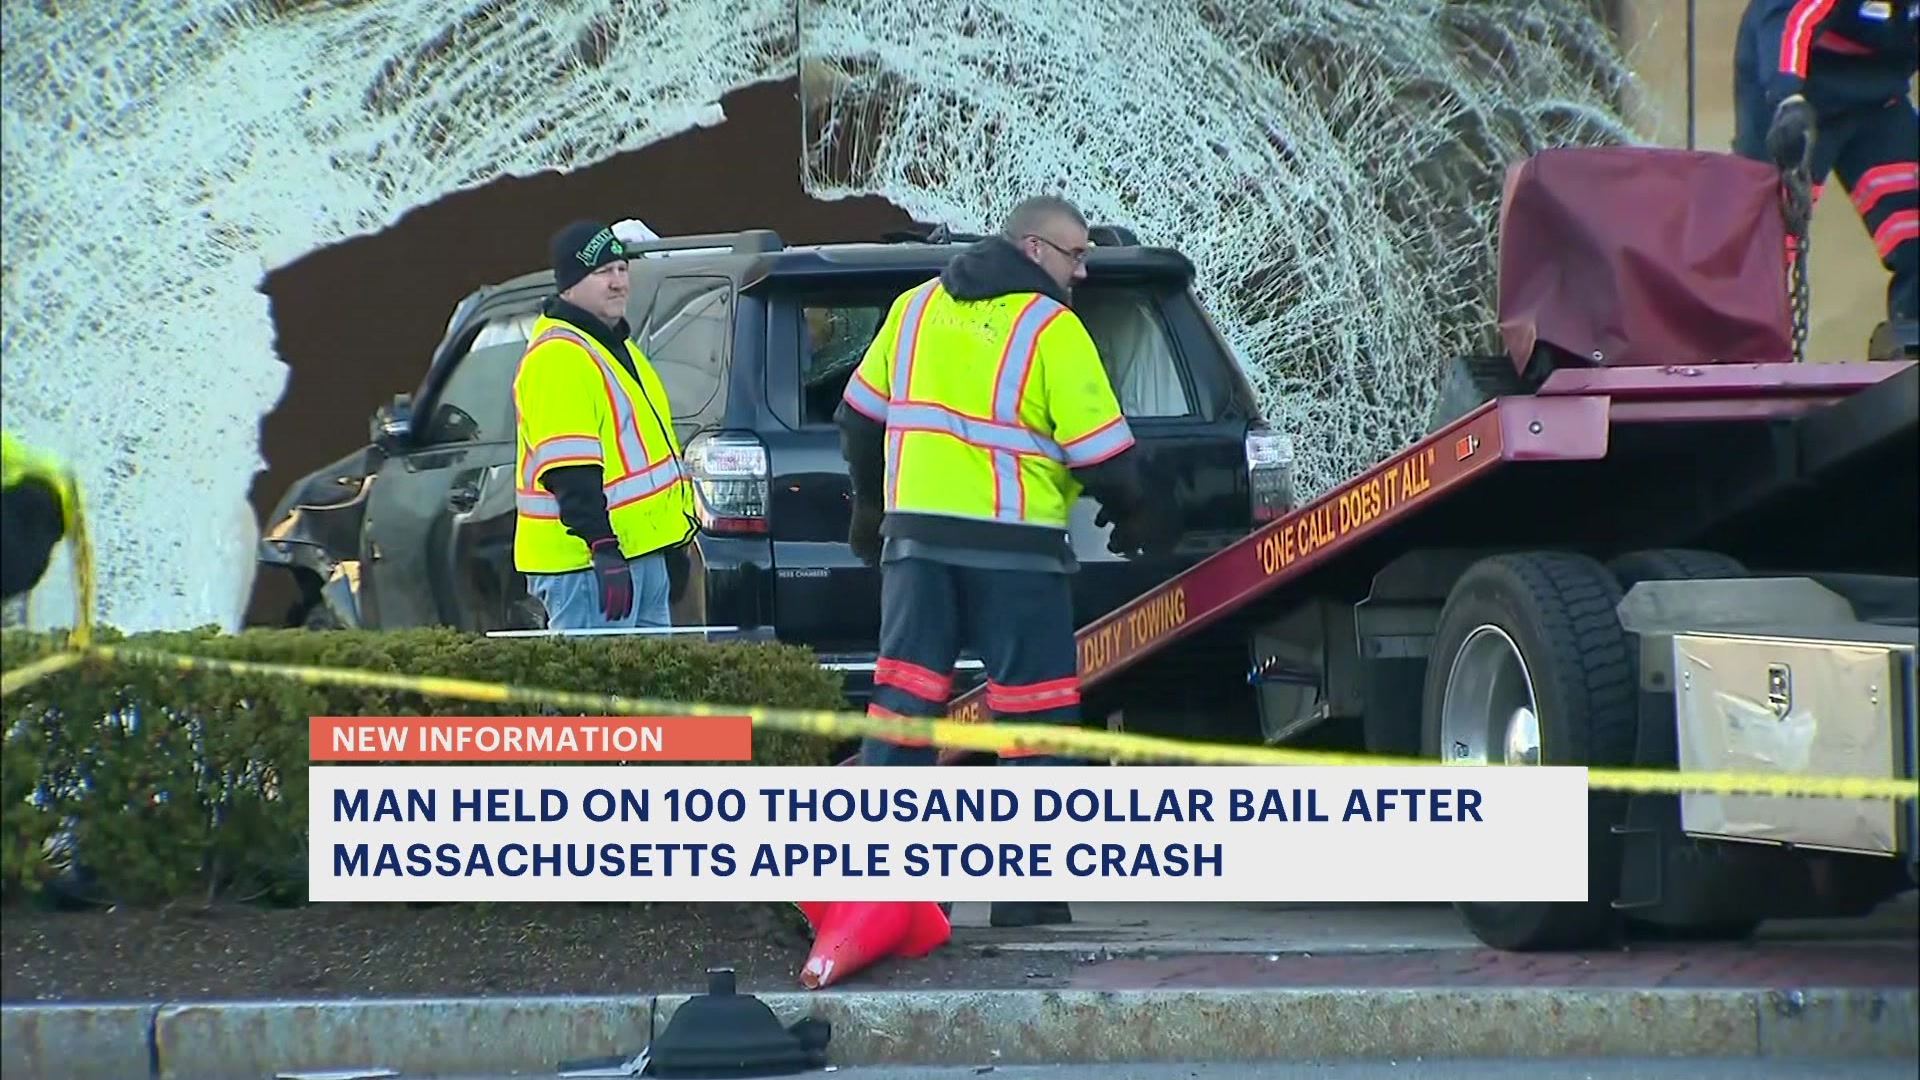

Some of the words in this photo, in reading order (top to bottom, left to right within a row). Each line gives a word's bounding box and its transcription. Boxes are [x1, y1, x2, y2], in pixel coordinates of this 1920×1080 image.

[1257, 525, 1295, 575] "ONE
[1298, 506, 1336, 556] CALL
[1339, 478, 1381, 534] DOES
[1384, 468, 1398, 510] IT
[1402, 448, 1435, 501] ALL"
[1084, 622, 1122, 674] DUTY
[1128, 587, 1185, 650] TOWING
